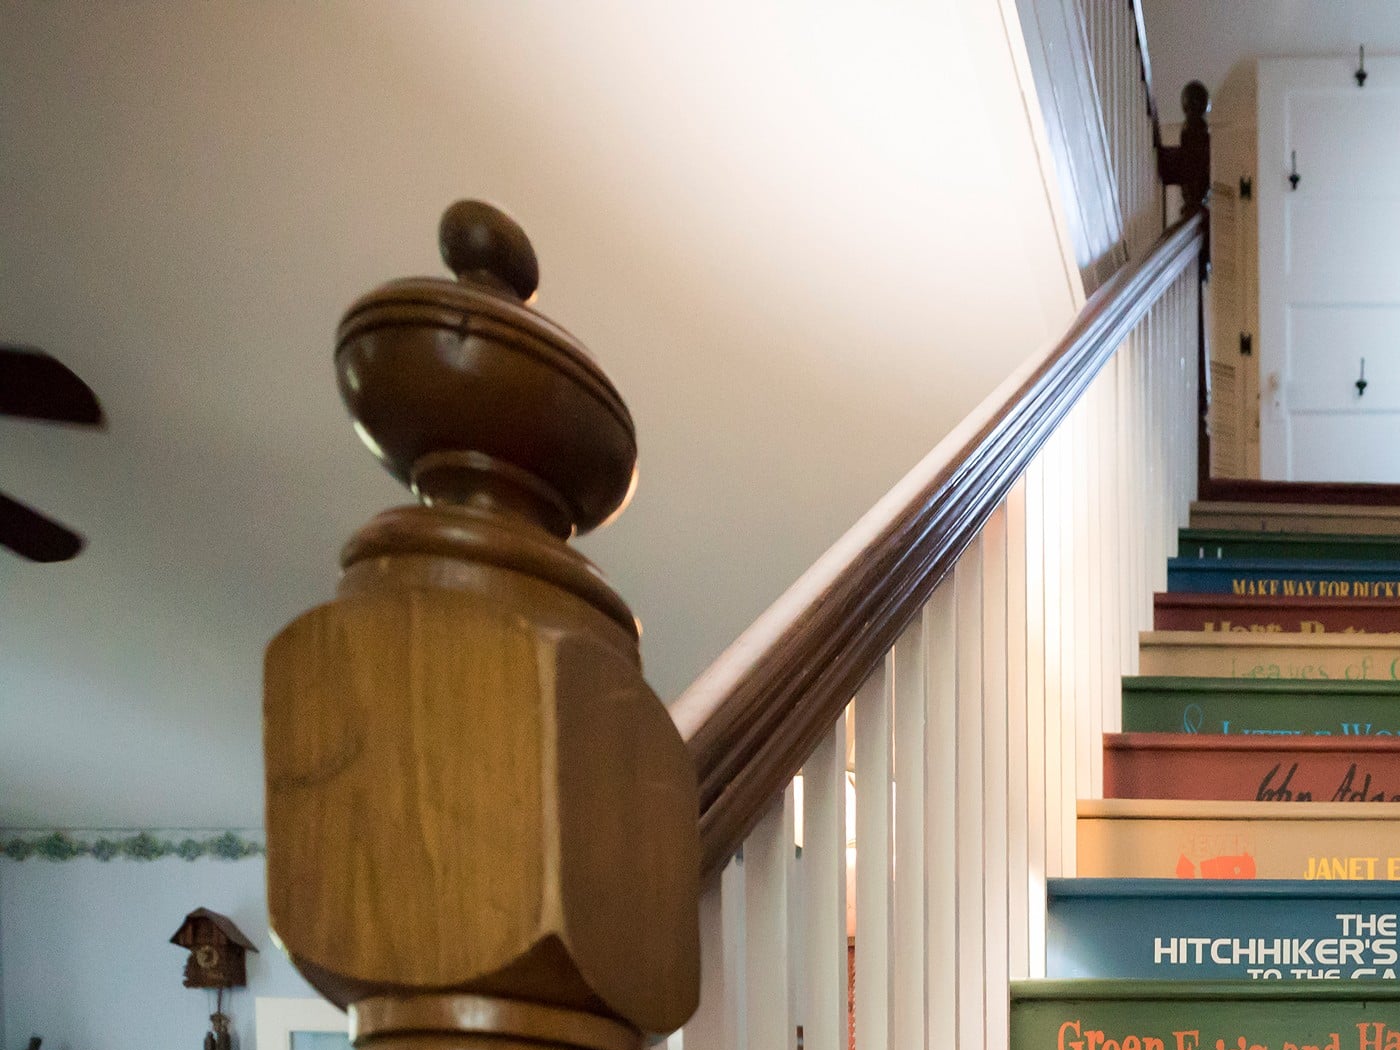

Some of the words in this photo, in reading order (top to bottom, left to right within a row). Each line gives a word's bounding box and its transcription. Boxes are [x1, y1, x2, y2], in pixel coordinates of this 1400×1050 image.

[1232, 579, 1279, 596] MAKE
[1283, 580, 1317, 596] WAY
[1319, 580, 1350, 597] FOR
[1304, 857, 1379, 880] JANET
[1336, 914, 1396, 936] THE
[1155, 938, 1397, 964] HITCHHIKER'S
